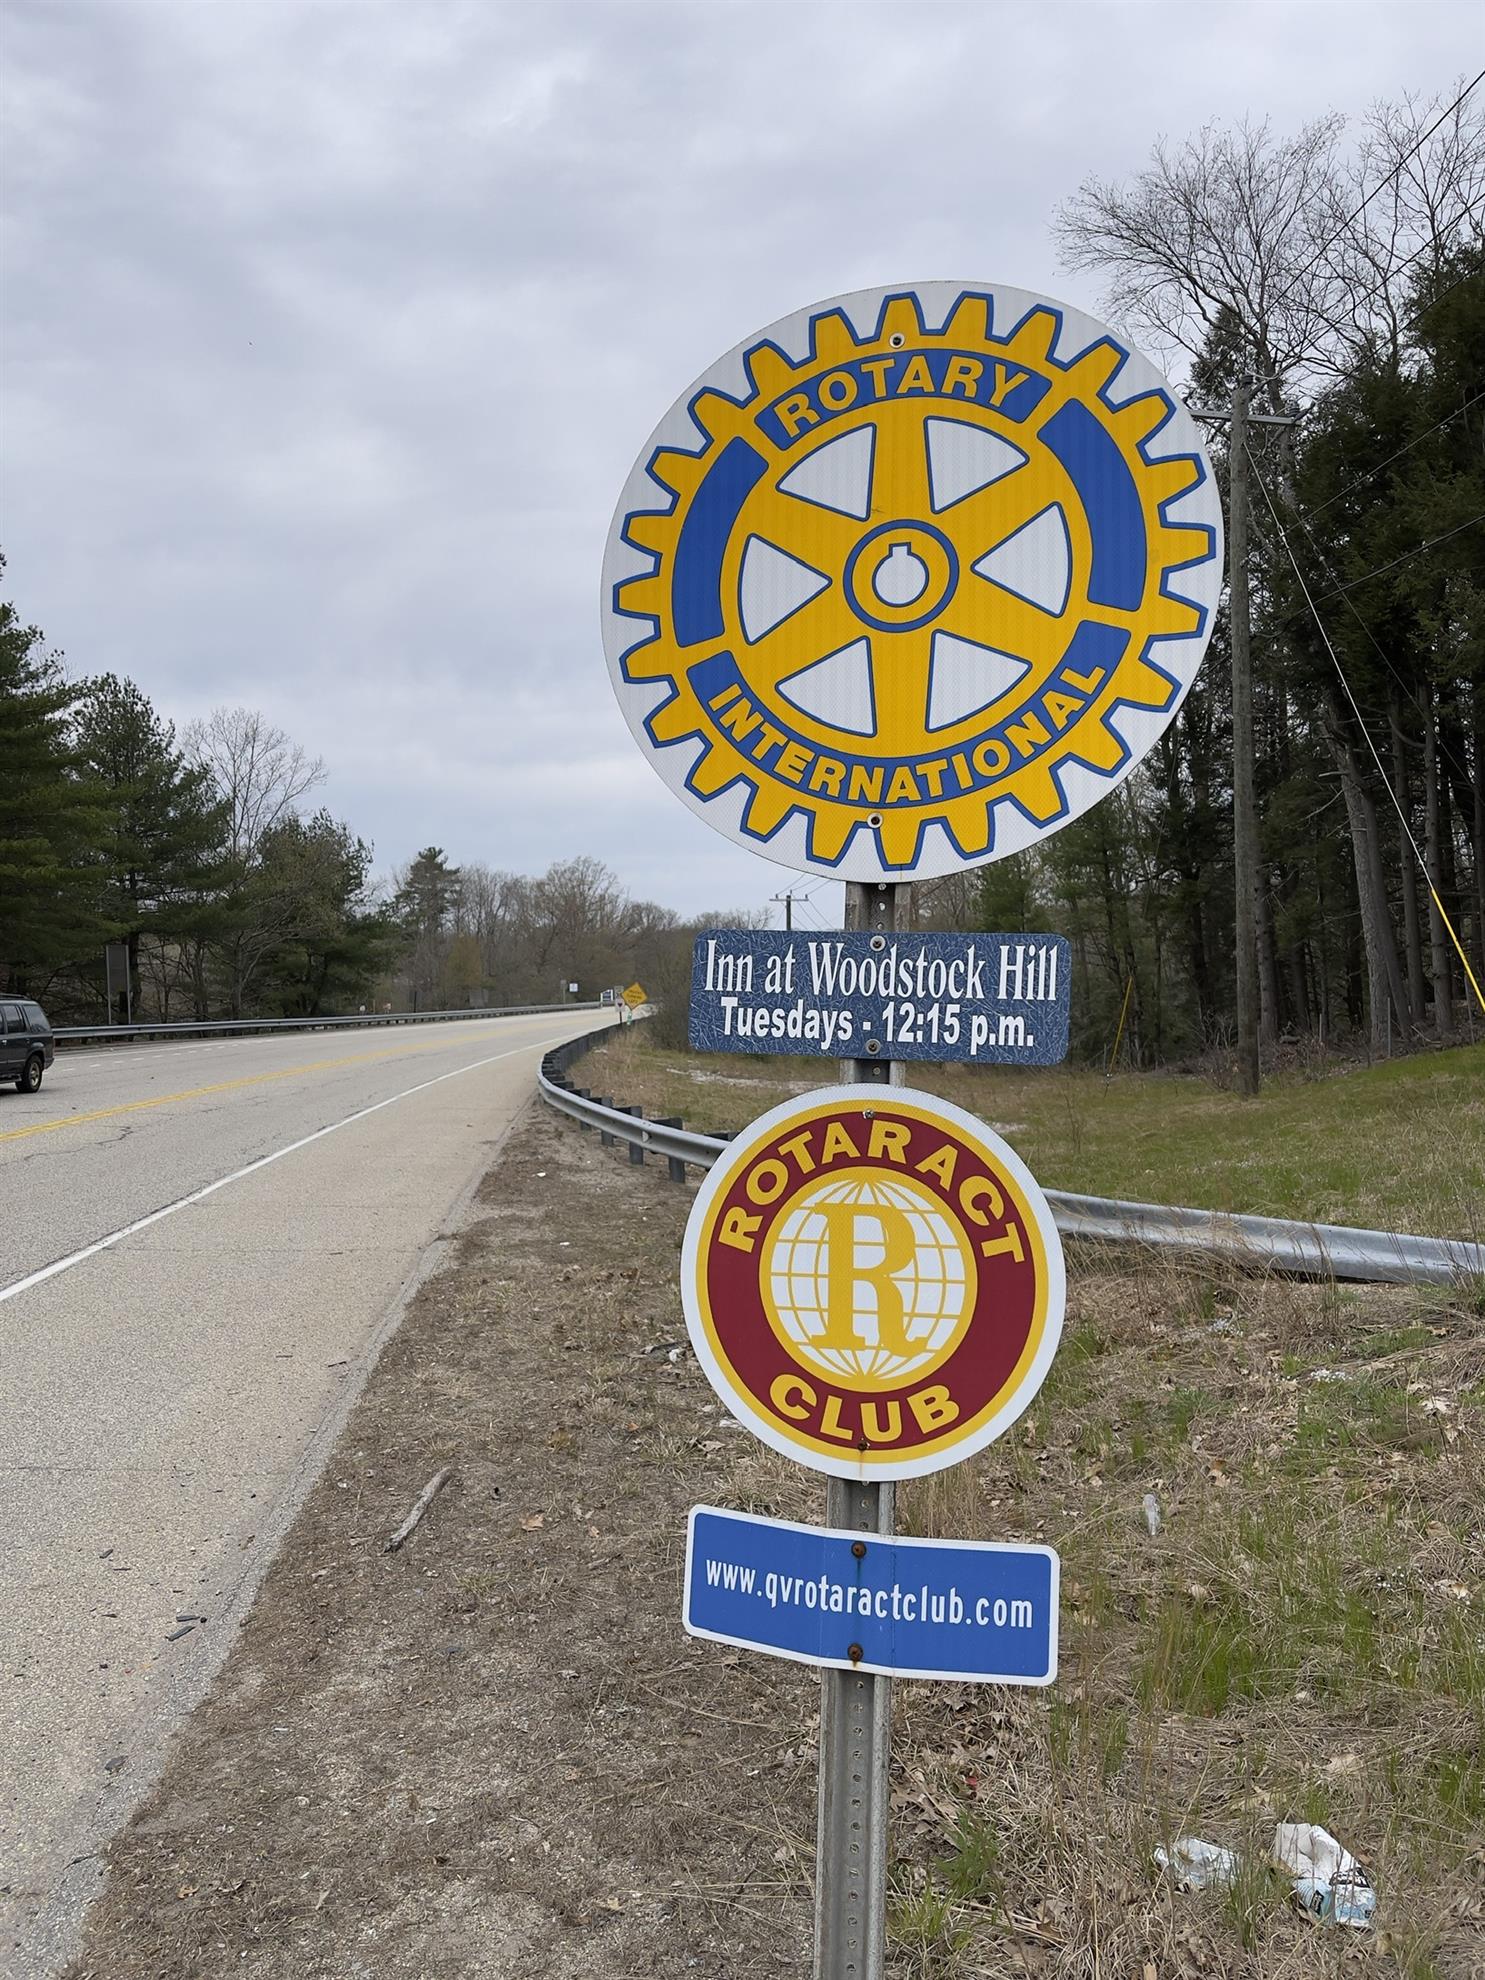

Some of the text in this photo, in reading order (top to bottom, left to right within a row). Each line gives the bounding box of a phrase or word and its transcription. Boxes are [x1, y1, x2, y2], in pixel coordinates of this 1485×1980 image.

[775, 355, 1034, 438] ROTARY
[707, 665, 1108, 804] INTERNATIONAL
[704, 939, 1058, 1001] Inn at Woodstock Hill
[720, 996, 853, 1050] Tuesdays
[882, 1001, 961, 1045] 12:15
[970, 1013, 1034, 1056] p.m.
[718, 1119, 1026, 1264] ROTARACT
[811, 1203, 929, 1358] R
[769, 1373, 961, 1442] CLUB
[705, 1559, 1034, 1629] www.qvrotaractclub.com
